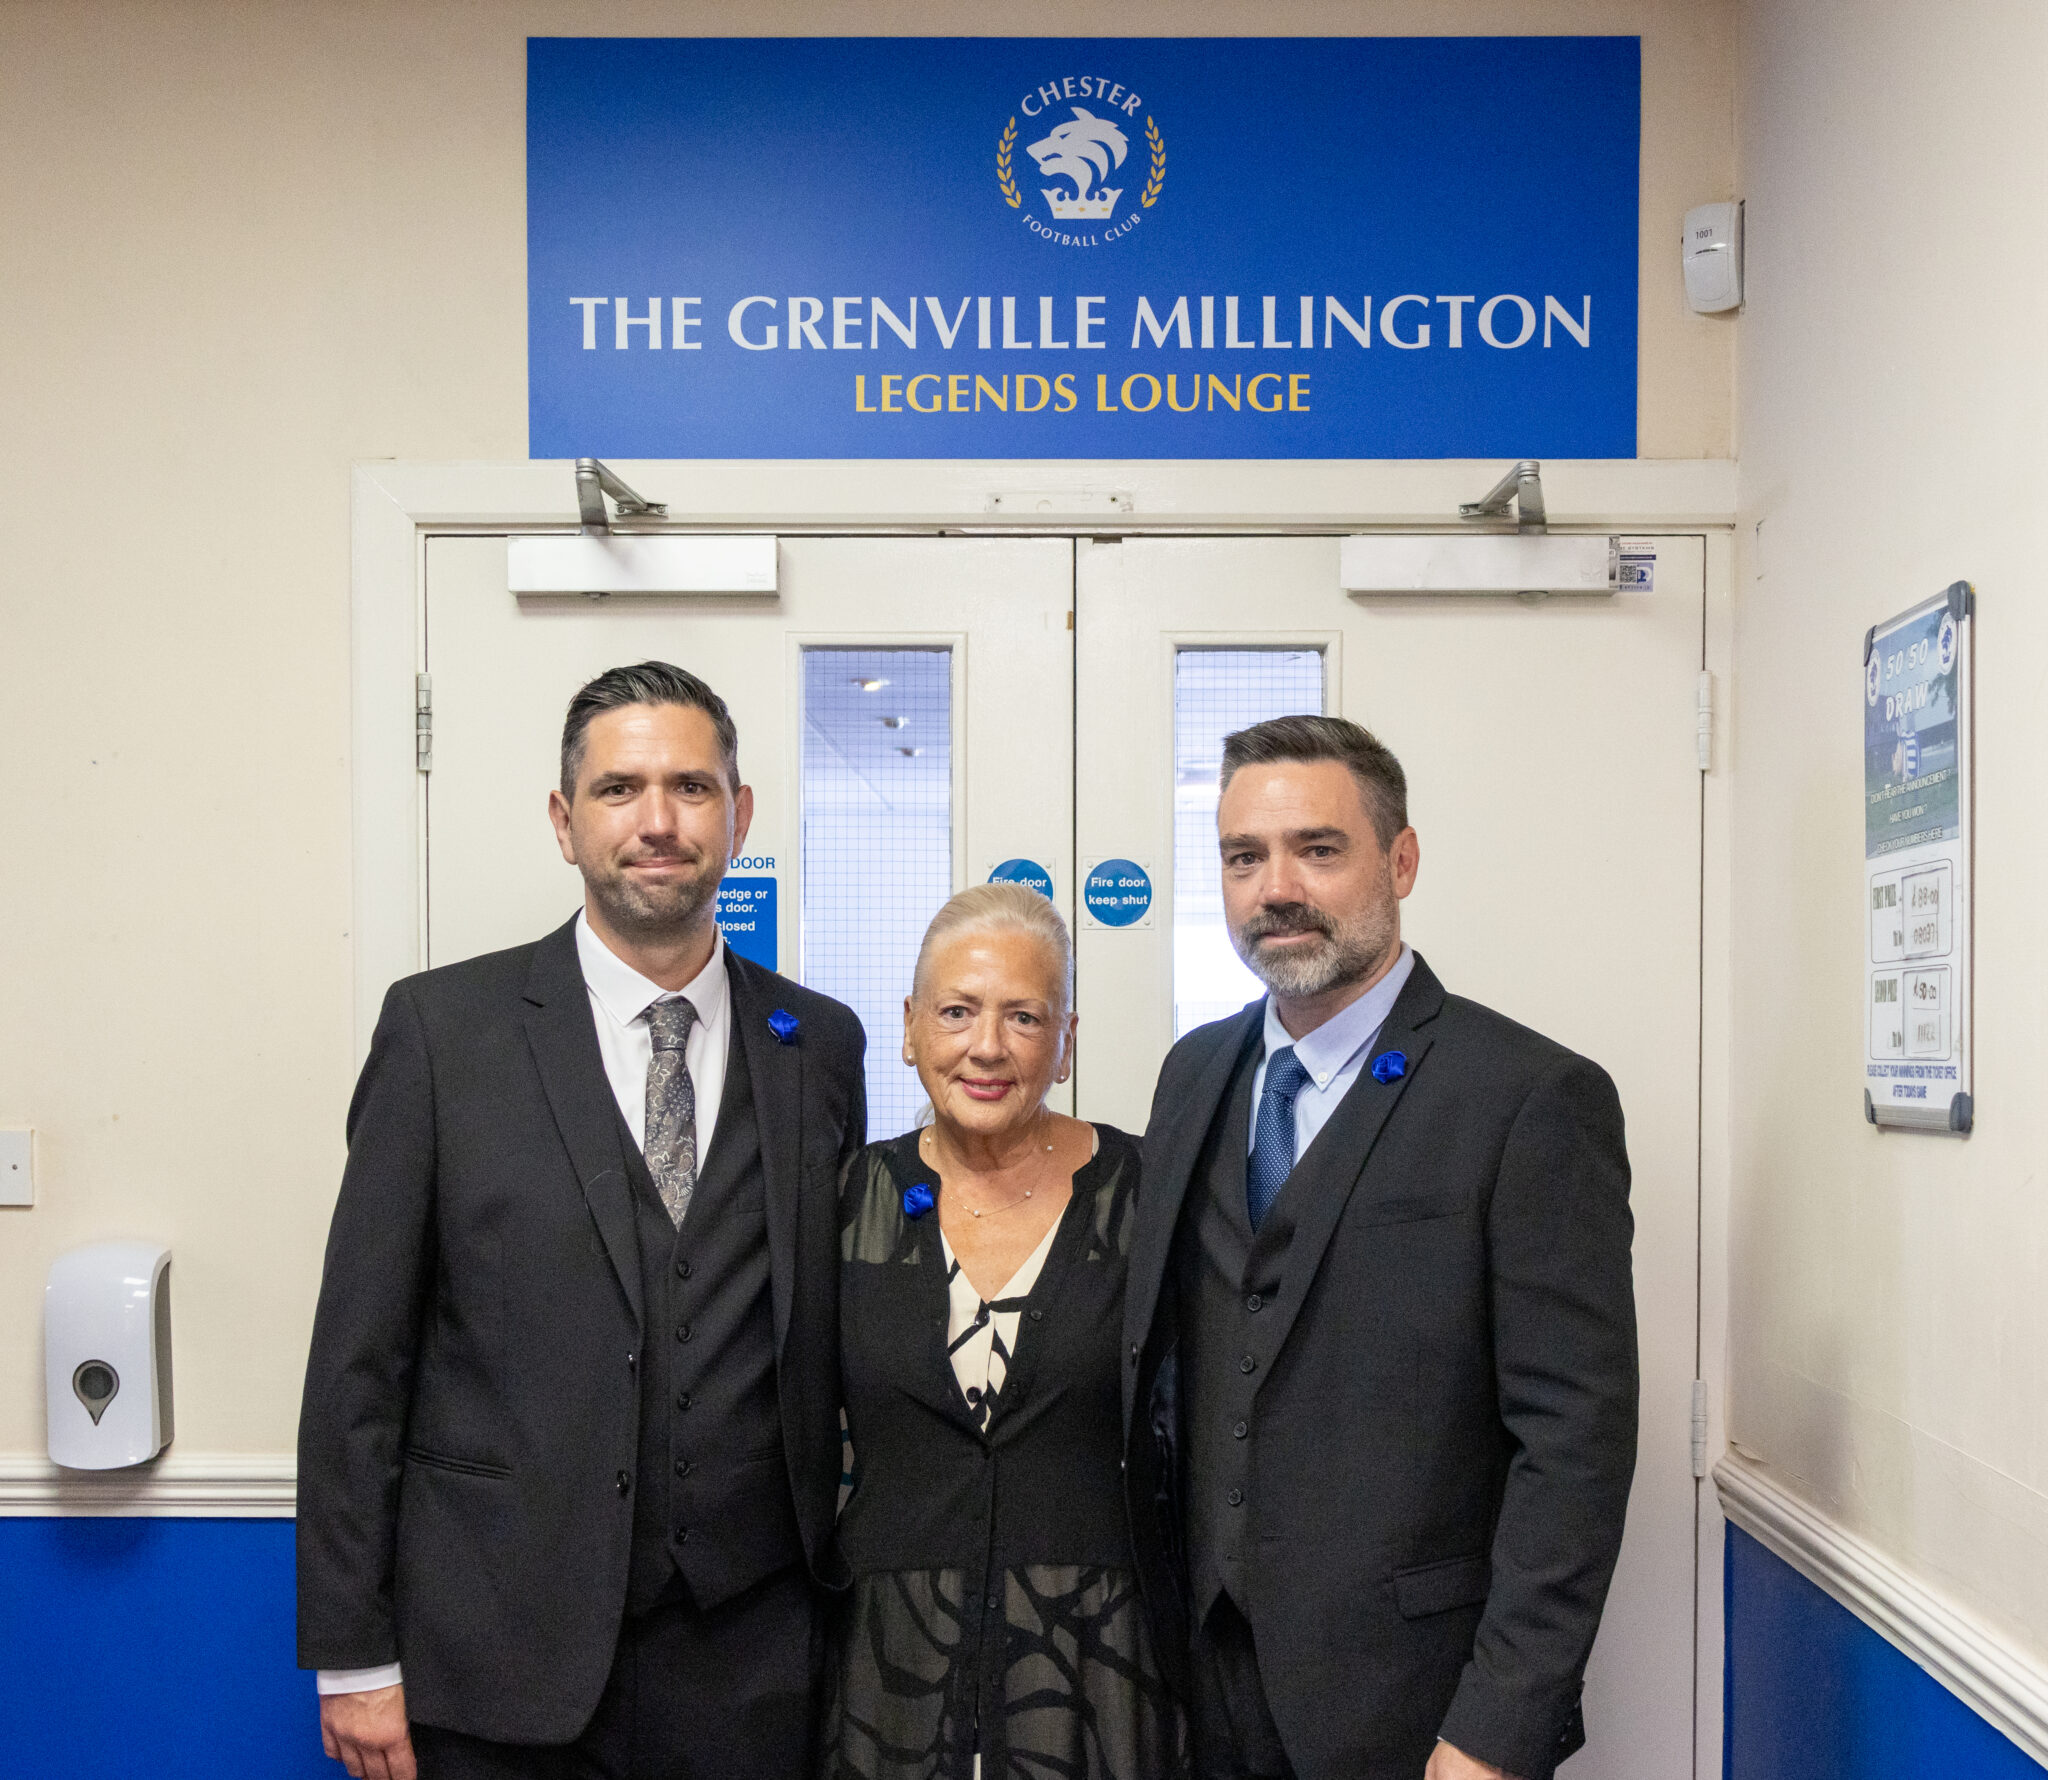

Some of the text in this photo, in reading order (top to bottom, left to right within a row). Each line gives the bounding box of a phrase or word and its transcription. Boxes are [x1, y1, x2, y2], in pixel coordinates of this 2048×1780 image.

[1021, 75, 1142, 117] CHESTER
[1022, 212, 1141, 247] FOOTBALL CLUB
[1695, 228, 1713, 240] 1001
[569, 294, 1593, 351] THE GRENVILLE MILLINGTON
[854, 373, 1311, 414] LEGENDS LOUNGE
[1886, 680, 1929, 722] DRAW
[730, 857, 776, 869] DOOR
[1020, 877, 1047, 888] door
[1091, 876, 1146, 888] Fire door
[754, 890, 768, 900] or
[1088, 894, 1148, 907] keep shut
[725, 901, 758, 913] door.
[719, 920, 756, 932] losed
